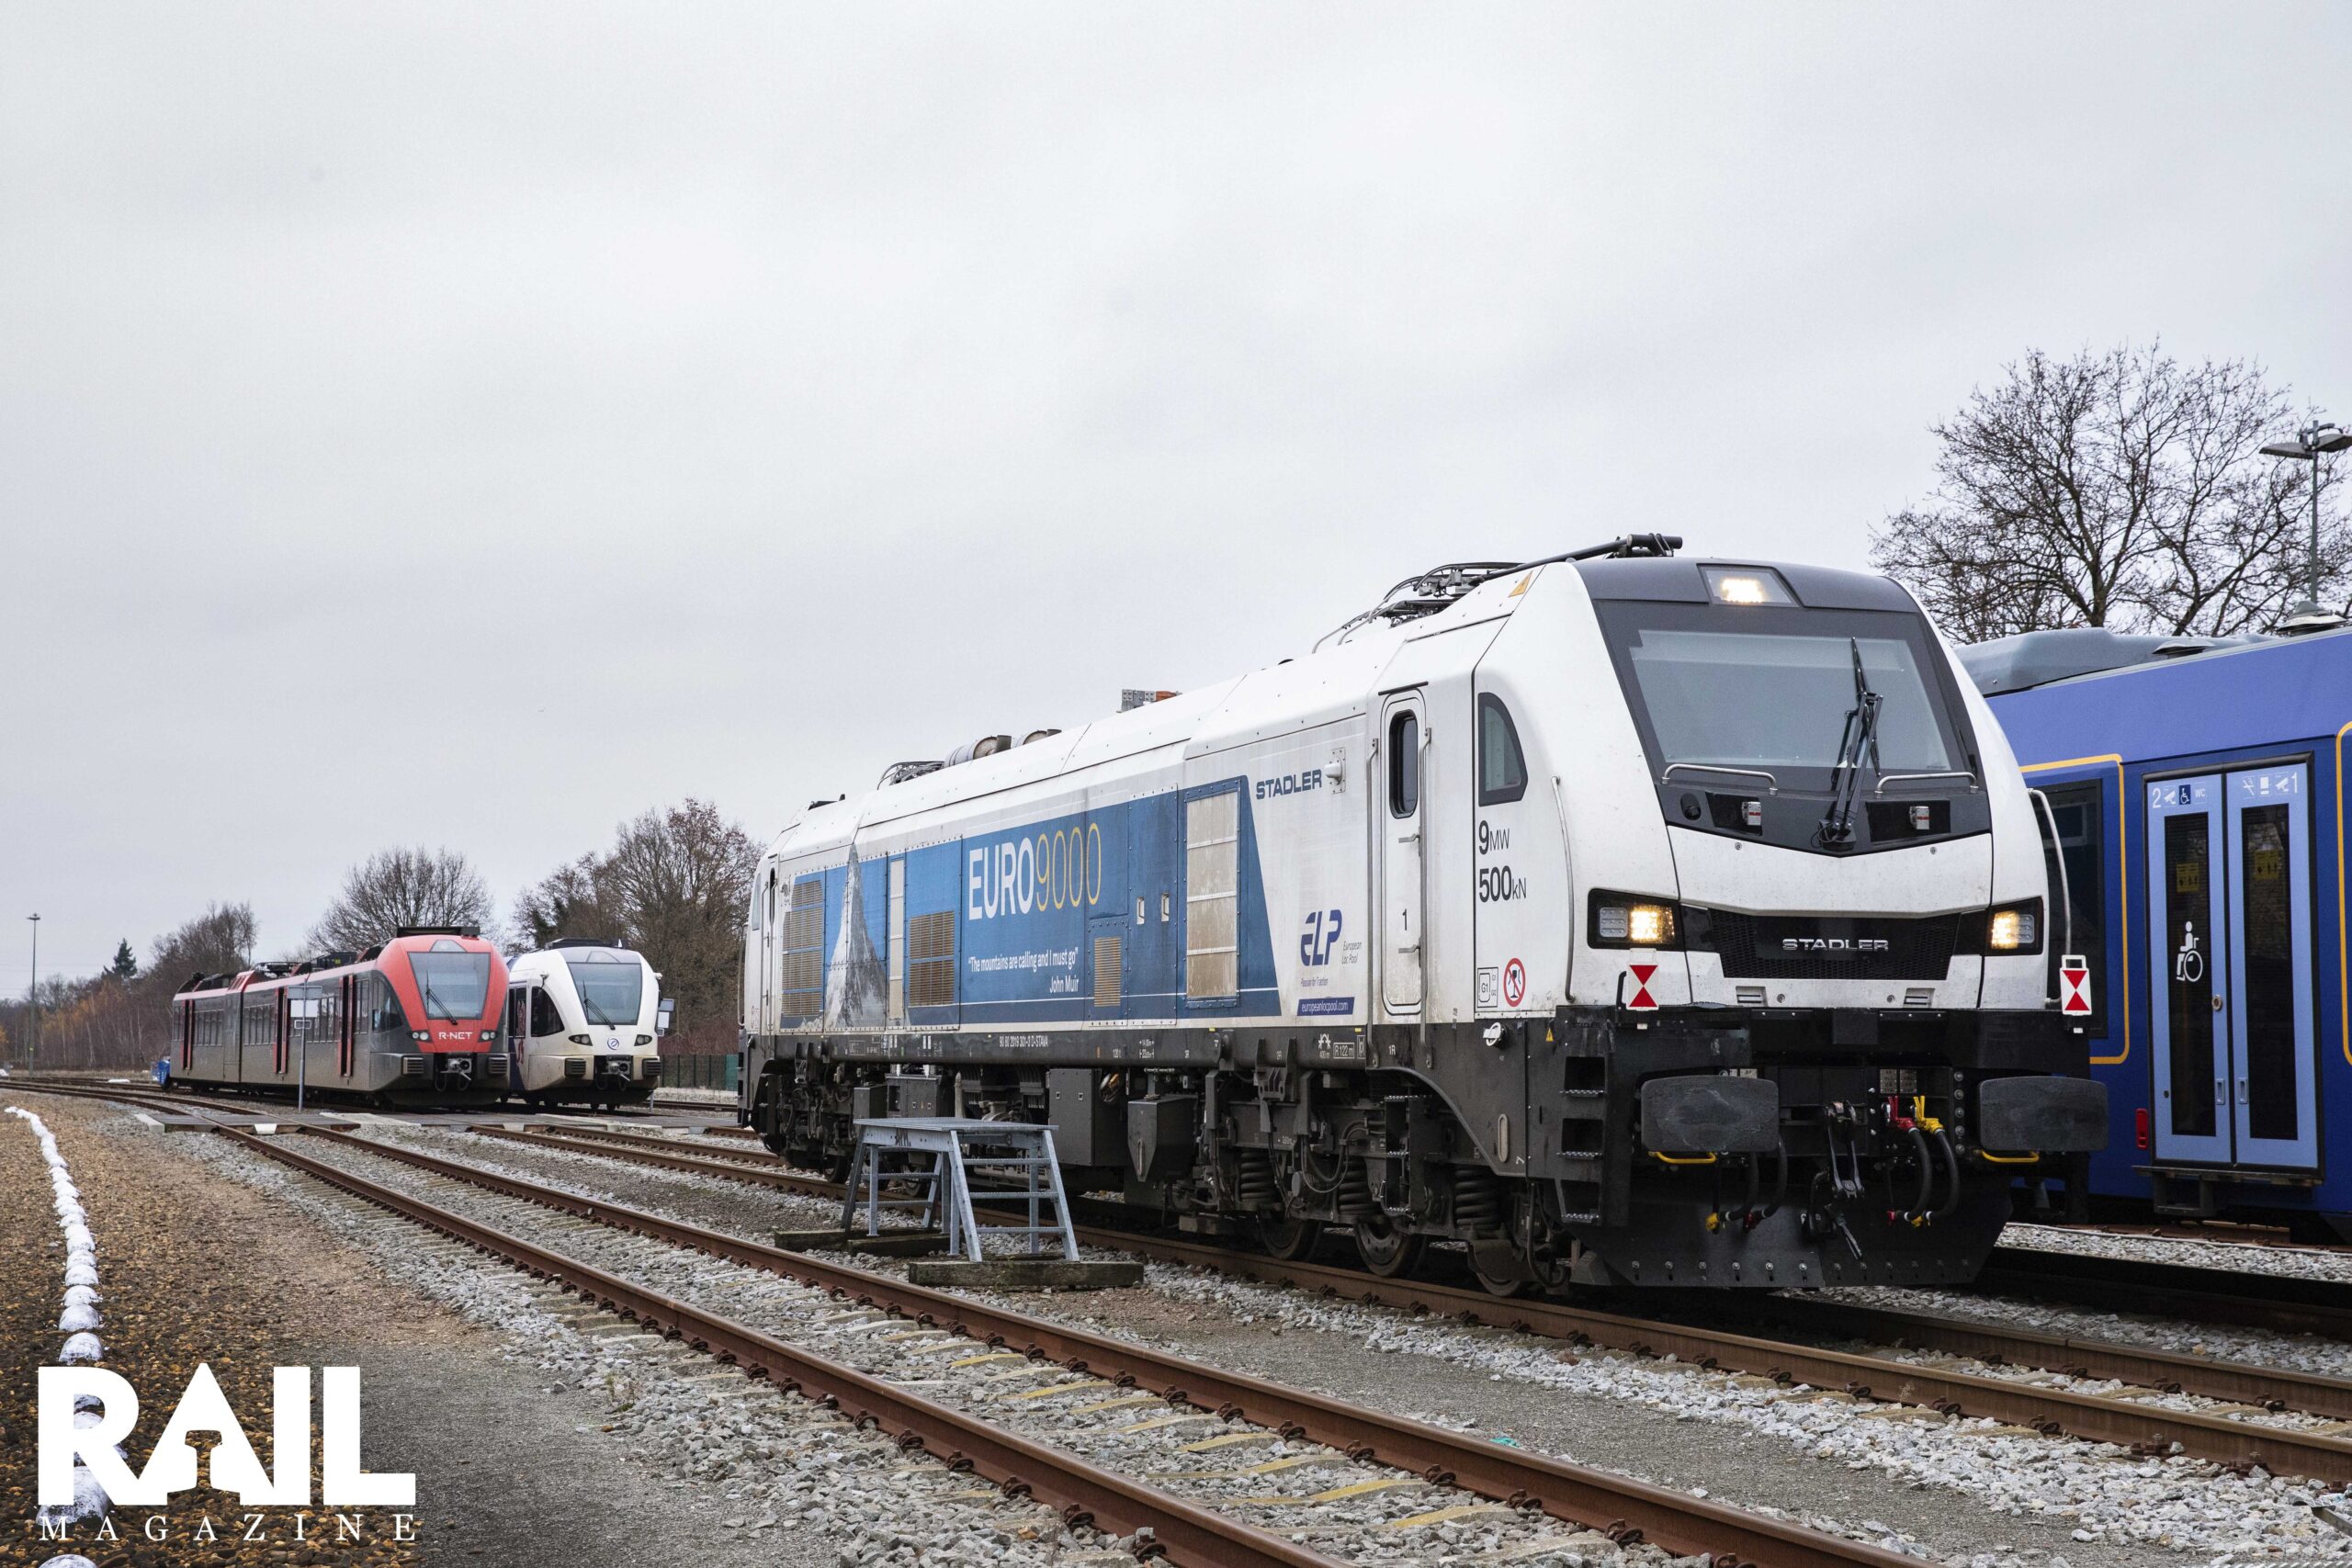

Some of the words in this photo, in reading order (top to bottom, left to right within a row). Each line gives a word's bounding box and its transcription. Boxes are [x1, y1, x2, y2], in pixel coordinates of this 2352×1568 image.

[1255, 769, 1322, 799] STADLER
[2291, 772, 2298, 794] 1
[2152, 787, 2161, 808] 2
[2195, 788, 2205, 798] WC
[968, 822, 1102, 920] EURO9000
[1402, 908, 1408, 931] 1
[1300, 908, 1342, 966] ELP
[1781, 937, 1890, 952] STADLER
[1342, 941, 1363, 953] European
[981, 953, 1009, 972] mountains
[1009, 956, 1018, 969] are
[1018, 951, 1037, 973] calling
[1037, 949, 1048, 967] and
[1052, 948, 1068, 965] must
[1049, 976, 1064, 993] John
[1065, 975, 1079, 992] Muir
[1481, 983, 1488, 993] G1
[1301, 1000, 1349, 1015] europeanlocpool.com
[1334, 1045, 1340, 1057] R
[1340, 1044, 1349, 1057] 122
[1349, 1047, 1354, 1056] m
[1388, 1044, 1396, 1055] 1R
